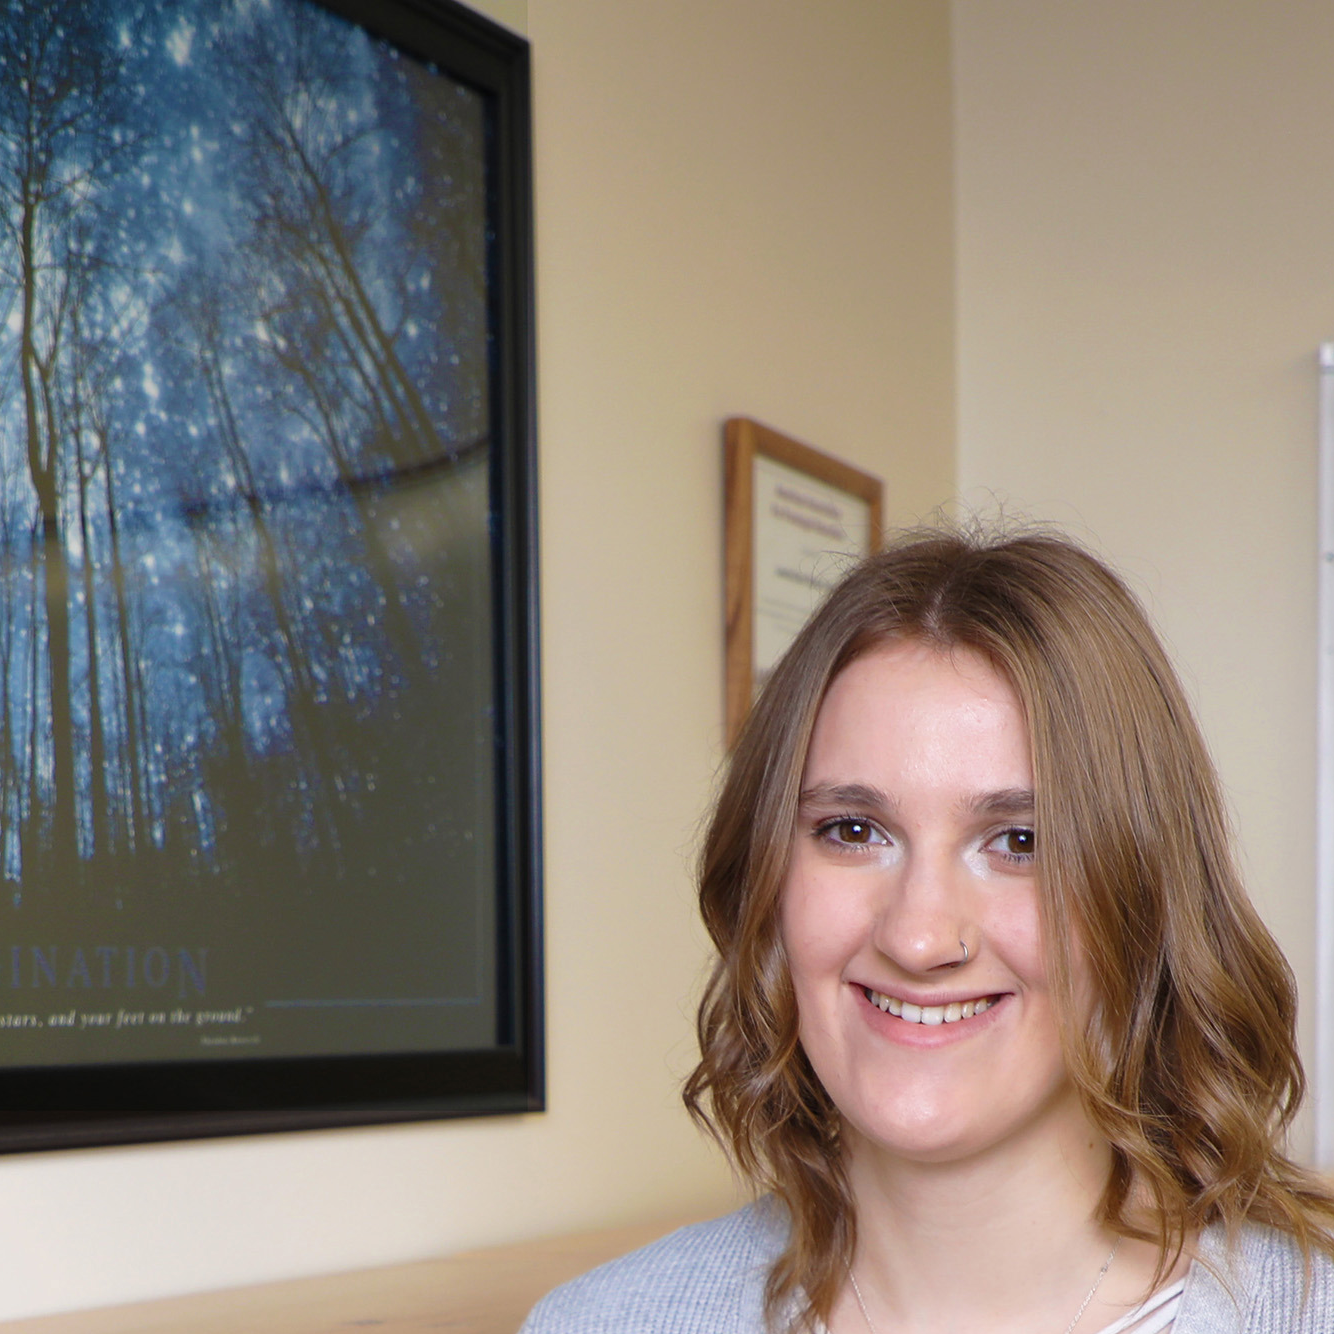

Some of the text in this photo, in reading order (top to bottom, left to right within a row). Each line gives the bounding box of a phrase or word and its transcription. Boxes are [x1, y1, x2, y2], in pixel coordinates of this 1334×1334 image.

[48, 1008, 76, 1027] and
[80, 1011, 113, 1030] your
[115, 1008, 145, 1030] feet
[148, 1012, 166, 1025] on
[170, 1007, 193, 1025] the
